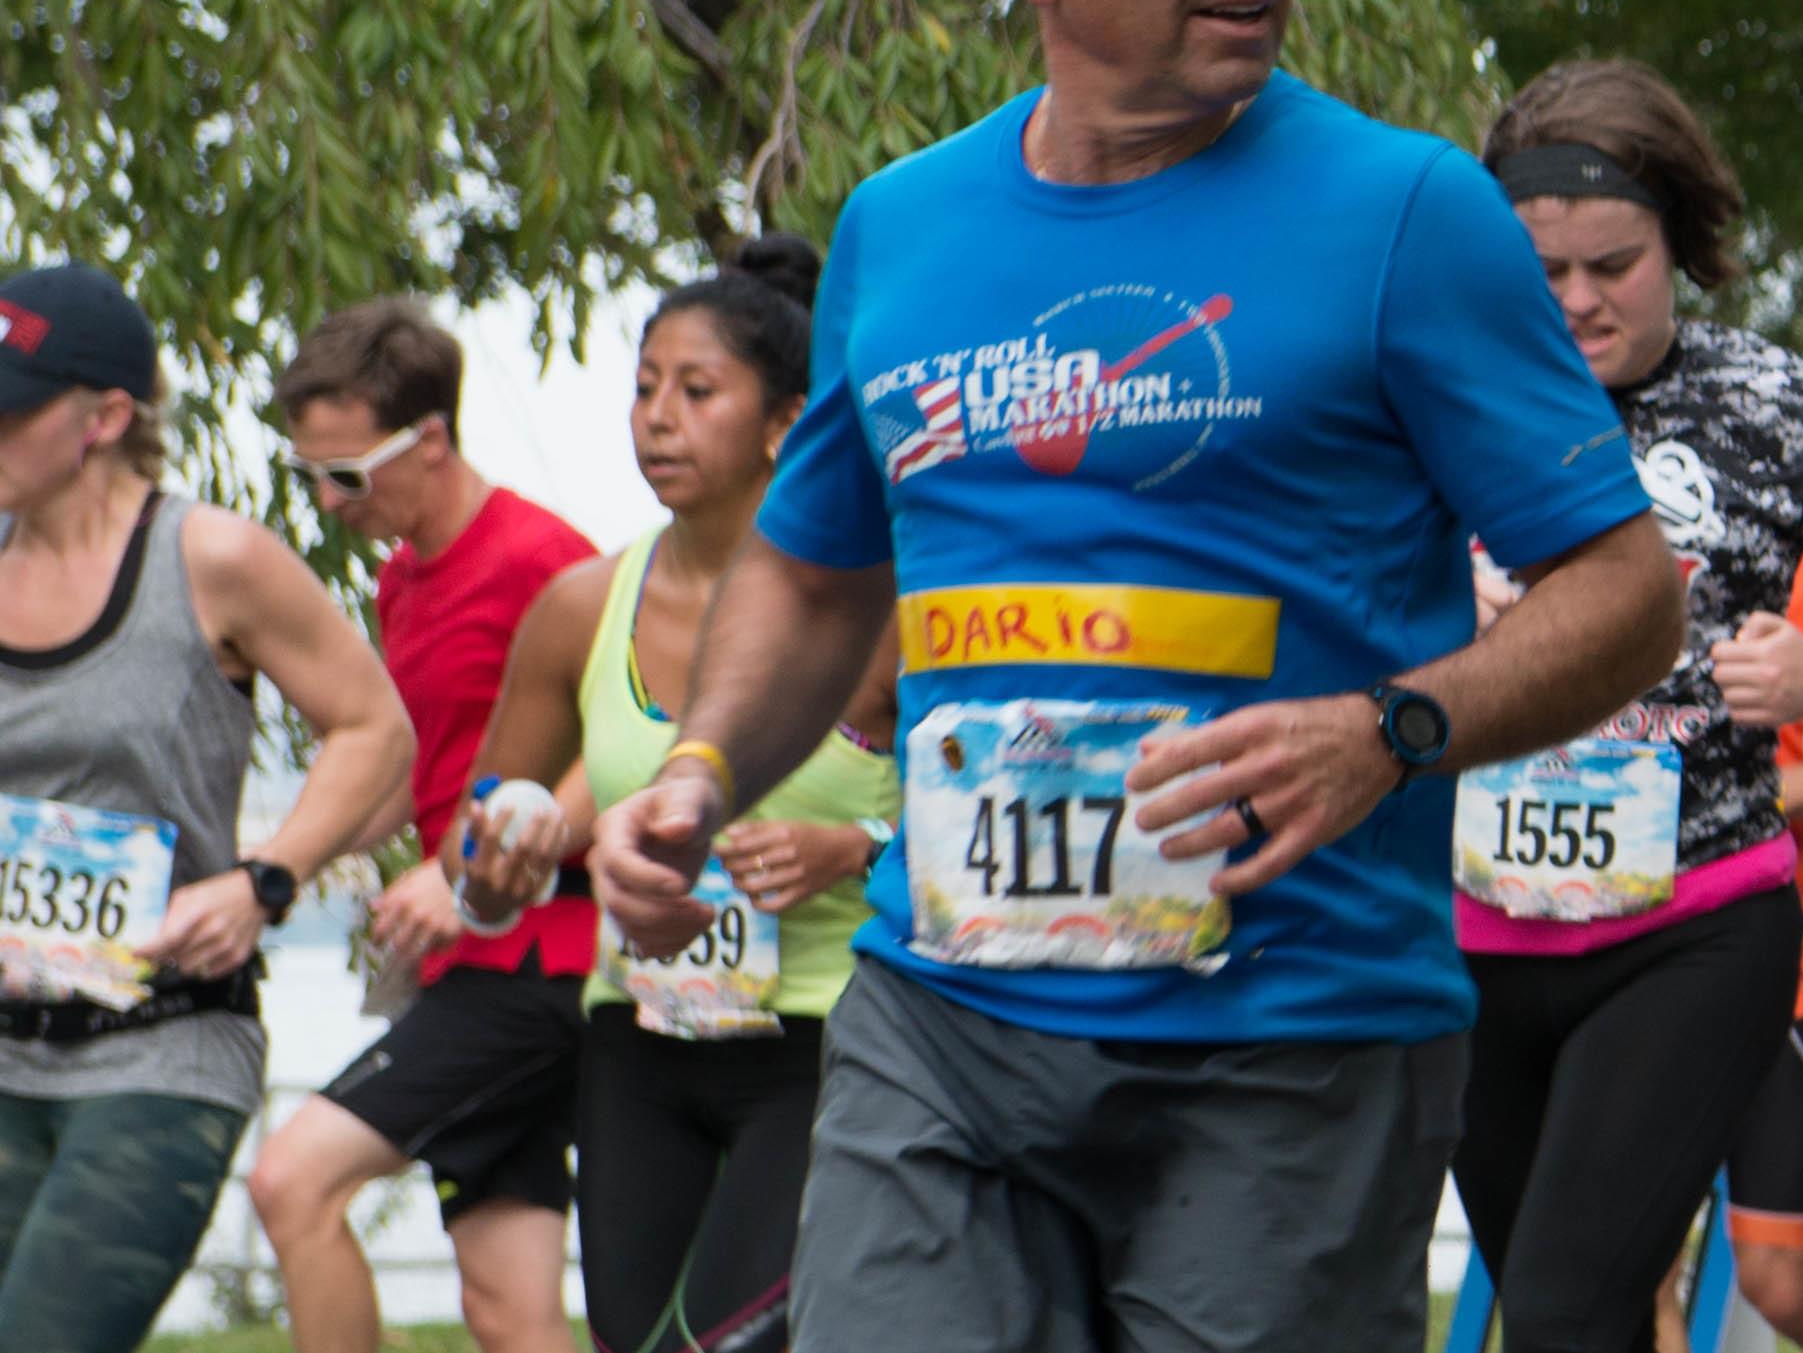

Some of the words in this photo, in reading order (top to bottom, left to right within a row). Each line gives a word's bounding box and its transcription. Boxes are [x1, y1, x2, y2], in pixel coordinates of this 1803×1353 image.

[964, 349, 1101, 406] USA
[974, 332, 1056, 370] ROLL
[969, 371, 1171, 435] MARATHON
[1118, 395, 1262, 429] MARATHON
[1600, 702, 1709, 745] OTC
[965, 797, 1126, 898] 4117
[1493, 798, 1616, 869] 1555
[0, 857, 129, 939] 15336
